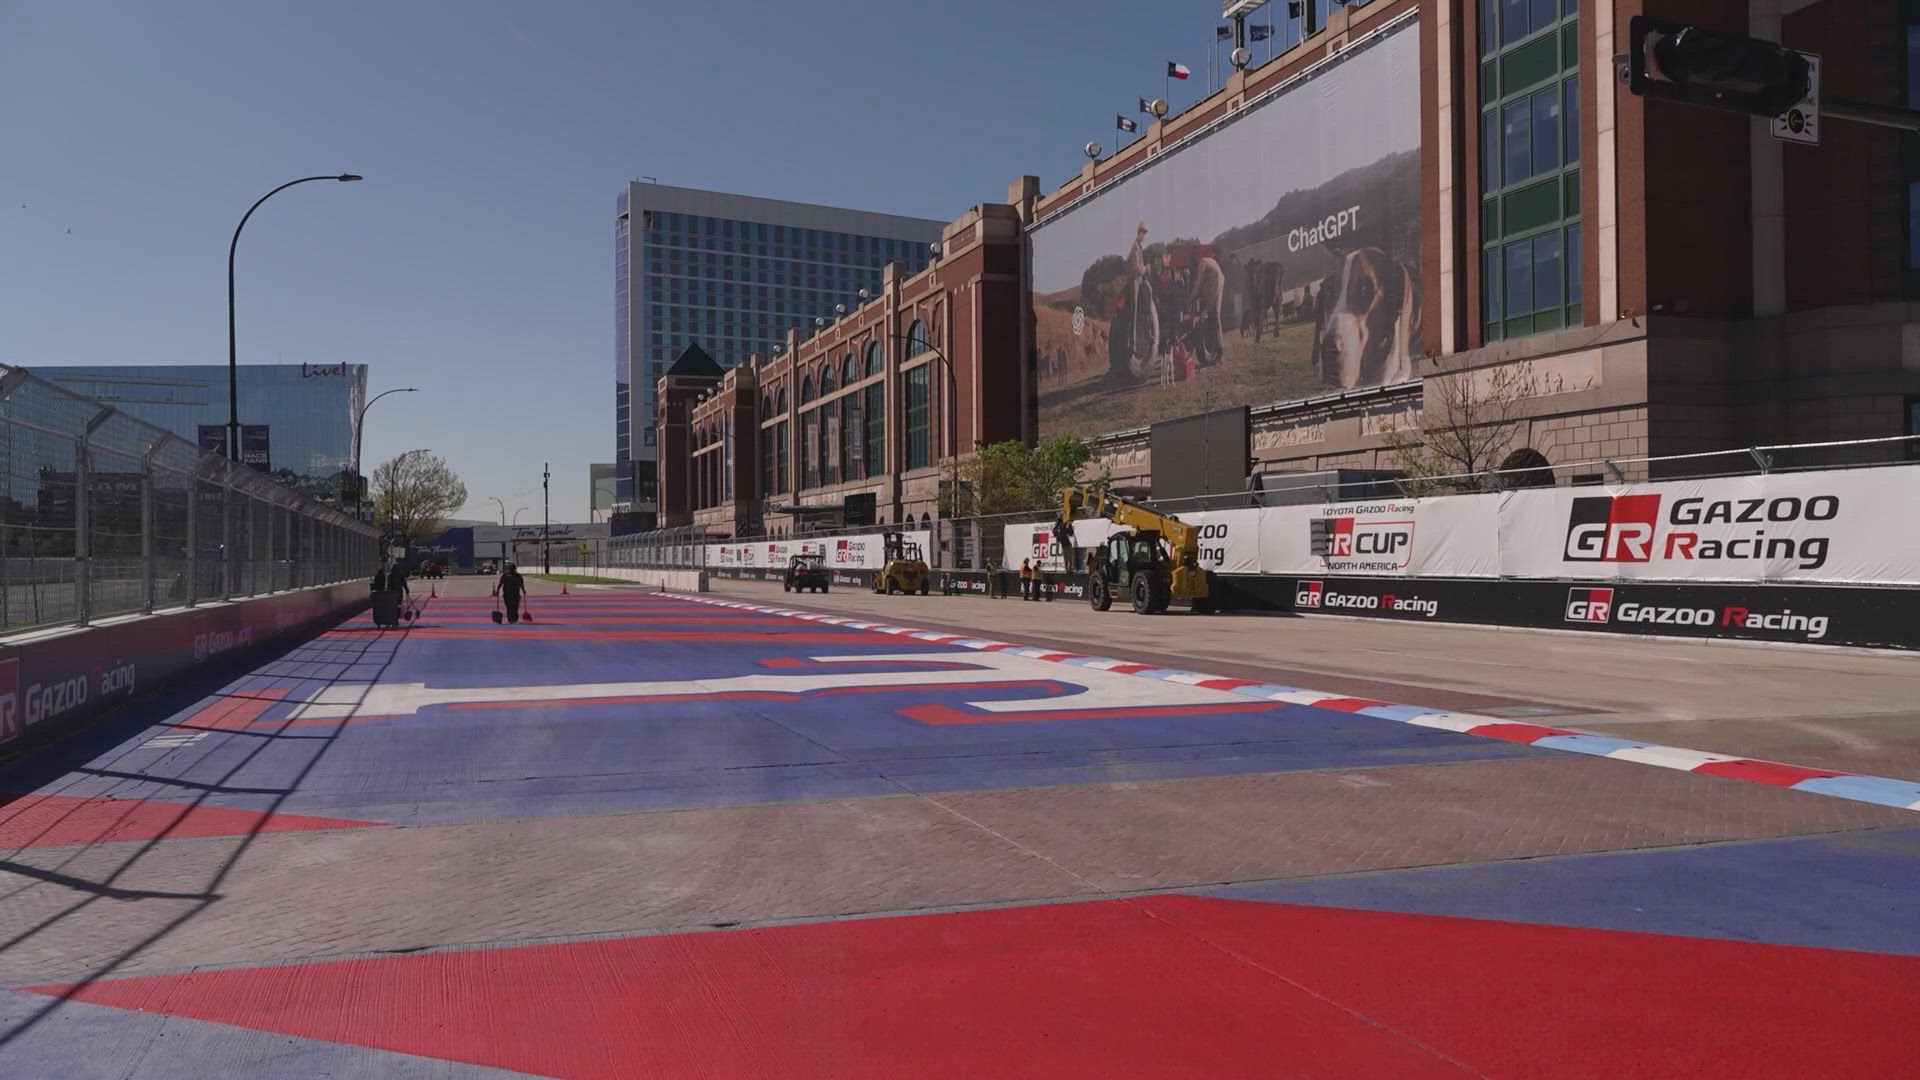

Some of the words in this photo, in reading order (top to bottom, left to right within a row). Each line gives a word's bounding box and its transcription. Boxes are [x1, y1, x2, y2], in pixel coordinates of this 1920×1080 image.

[1288, 205, 1360, 252] ChatGPT
[301, 361, 346, 378] Live!
[1323, 507, 1354, 516] TOYOTA
[1355, 505, 1386, 514] GAZOO
[1387, 503, 1415, 514] Racing
[1668, 495, 1840, 526] GAZOO
[512, 526, 536, 538] Tom
[536, 525, 574, 538] Thumb
[1196, 524, 1228, 539] ZOO
[1567, 521, 1654, 561] GR
[1050, 543, 1063, 557] CU
[1355, 532, 1409, 554] CUP
[1663, 530, 1829, 570] Racing
[1199, 543, 1225, 566] ing
[1328, 561, 1358, 571] NORTH
[1359, 561, 1398, 571] AMERICA
[1057, 582, 1083, 597] Racing
[1297, 591, 1321, 606] GR
[1325, 592, 1379, 609] GAZOO
[1381, 593, 1438, 617] Racing
[1567, 600, 1609, 622] GR
[1617, 603, 1715, 626] GAZOO
[1722, 605, 1829, 639] Racing
[0, 693, 17, 736] R
[25, 674, 88, 726] GAZOO
